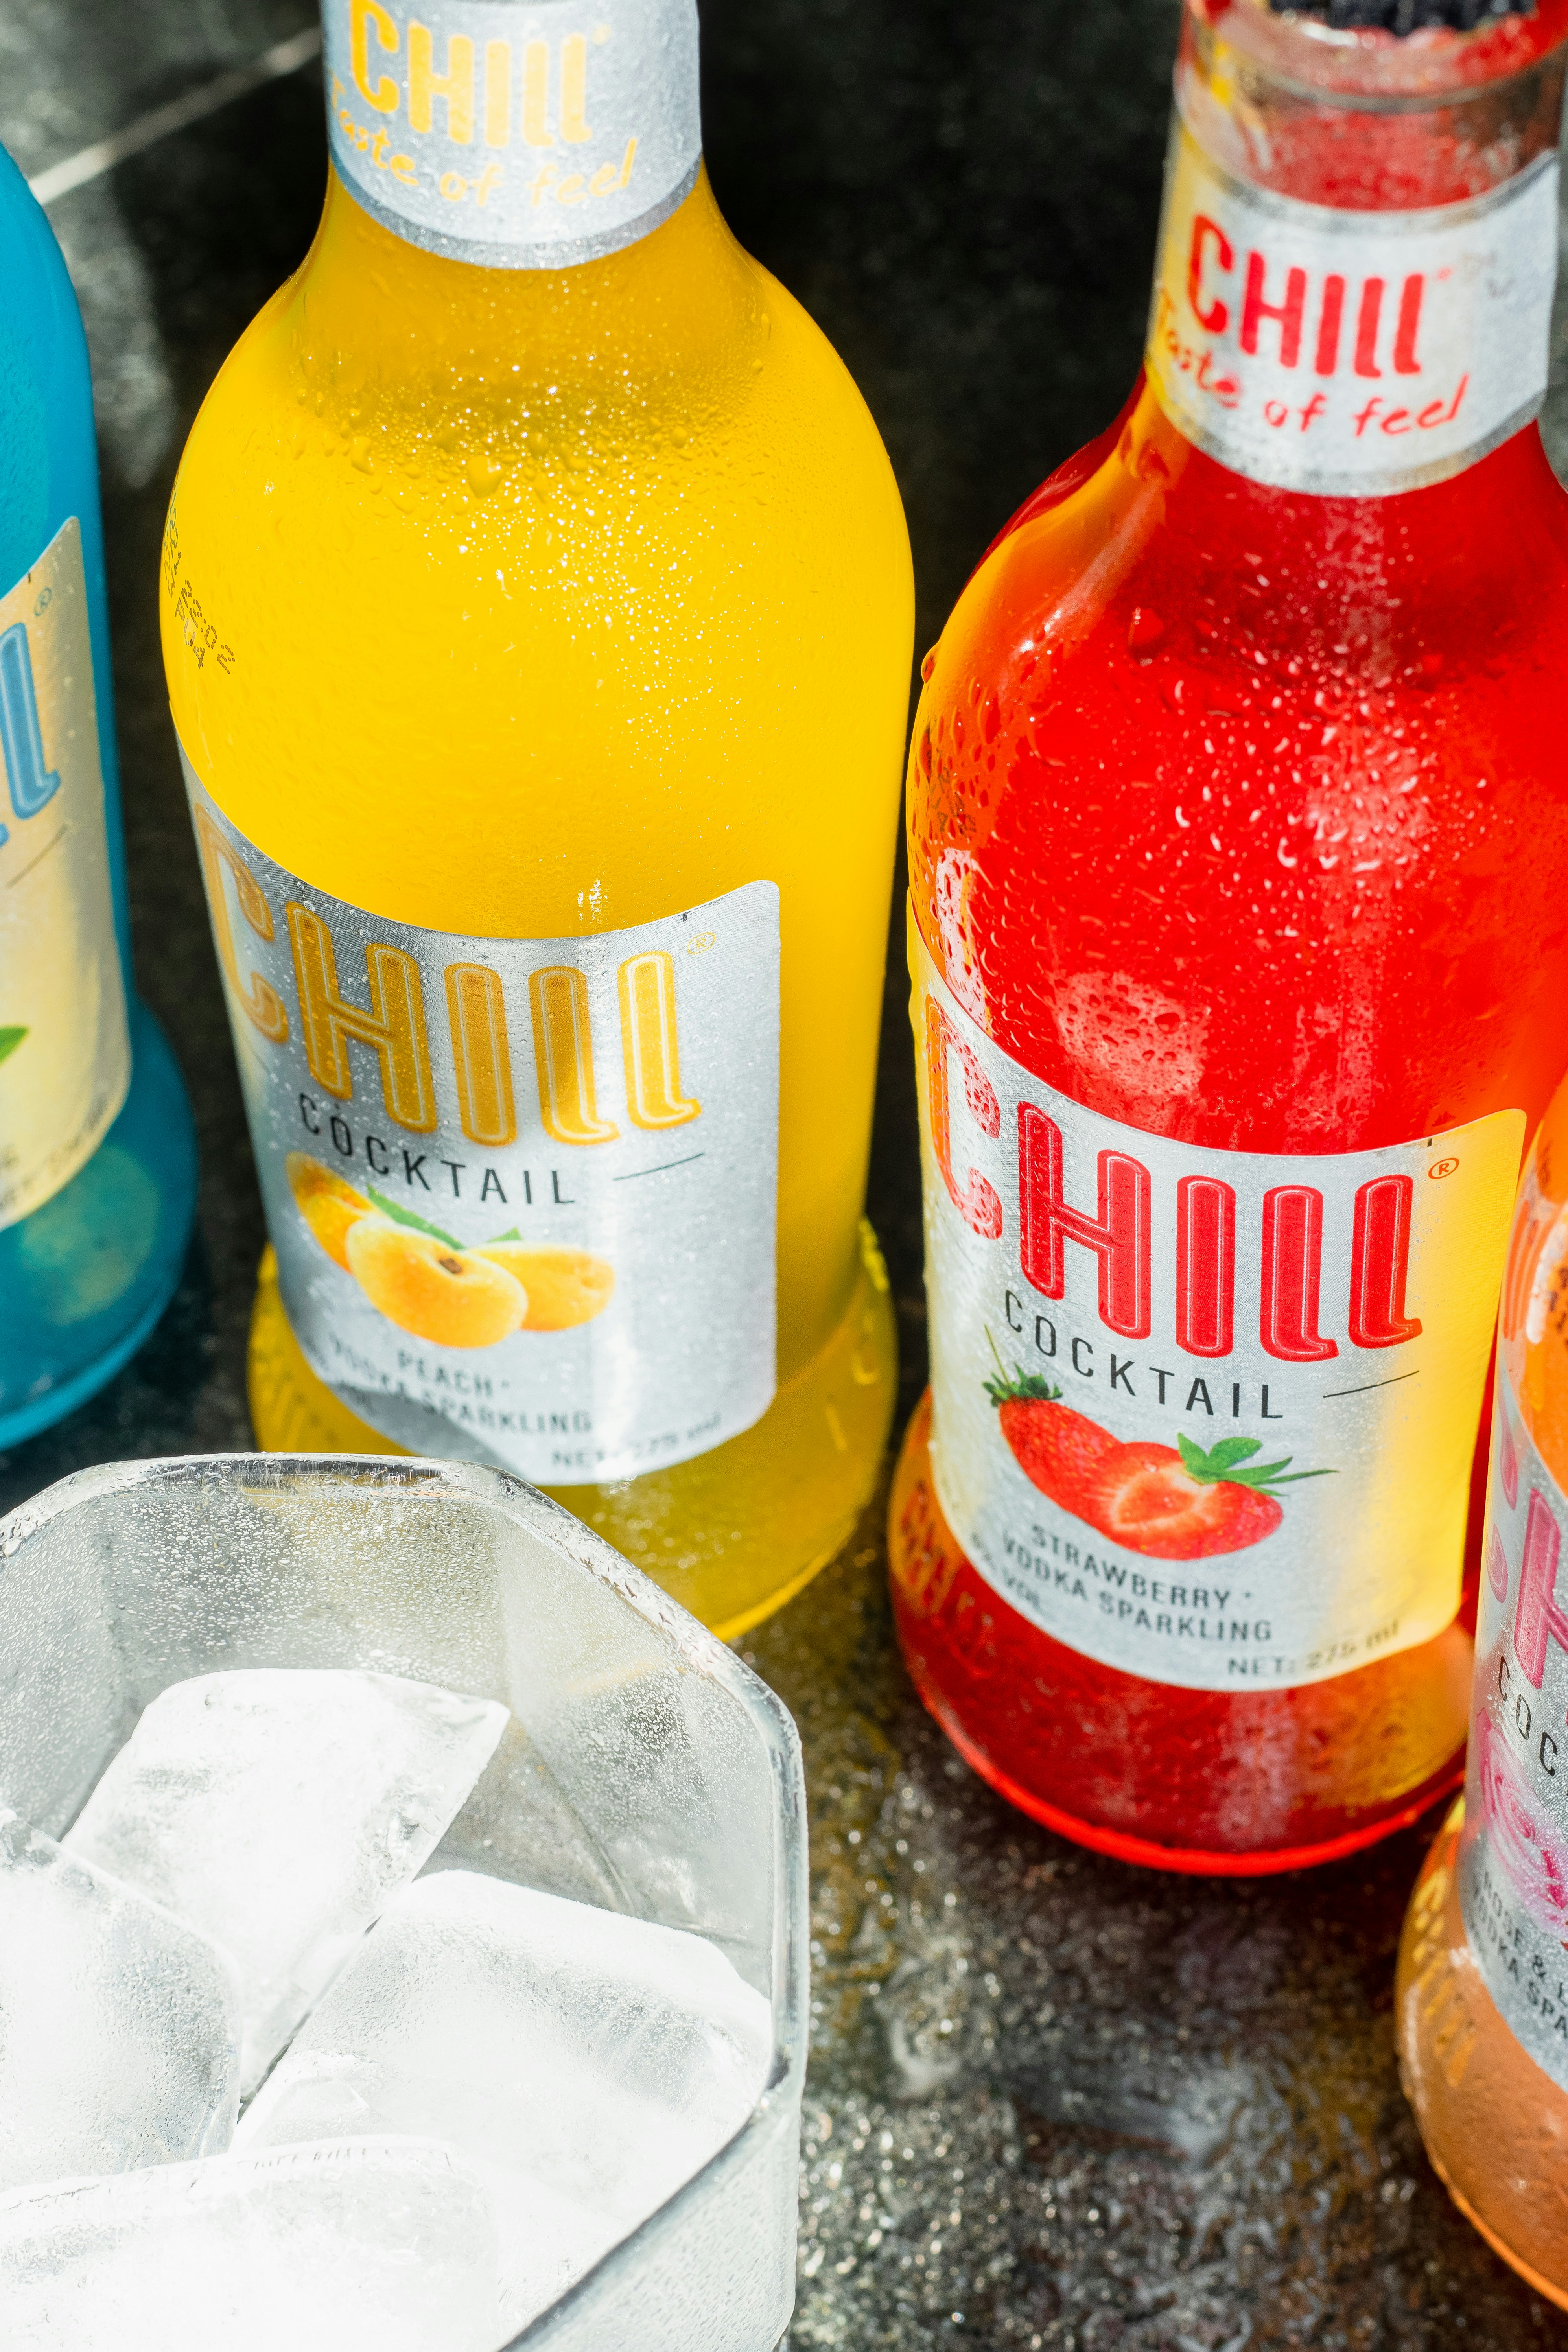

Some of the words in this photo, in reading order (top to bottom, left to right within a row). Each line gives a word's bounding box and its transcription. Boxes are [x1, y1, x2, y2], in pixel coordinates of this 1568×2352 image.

[349, 0, 593, 149] CHILL
[439, 162, 503, 207] of
[528, 137, 638, 207] feel
[1187, 214, 1424, 378] CHILL
[1264, 393, 1326, 433] of
[1354, 373, 1470, 437] feel
[196, 803, 702, 1146] CHILL
[298, 1091, 575, 1205] COCKTAIL
[926, 994, 1423, 1362] CHILL
[1005, 1288, 1284, 1419] COCKTAIL
[1002, 1528, 1089, 1602] VODKA
[1098, 1589, 1273, 1643] SPARKLING
[1032, 1523, 1232, 1610] STRAWBERRY
